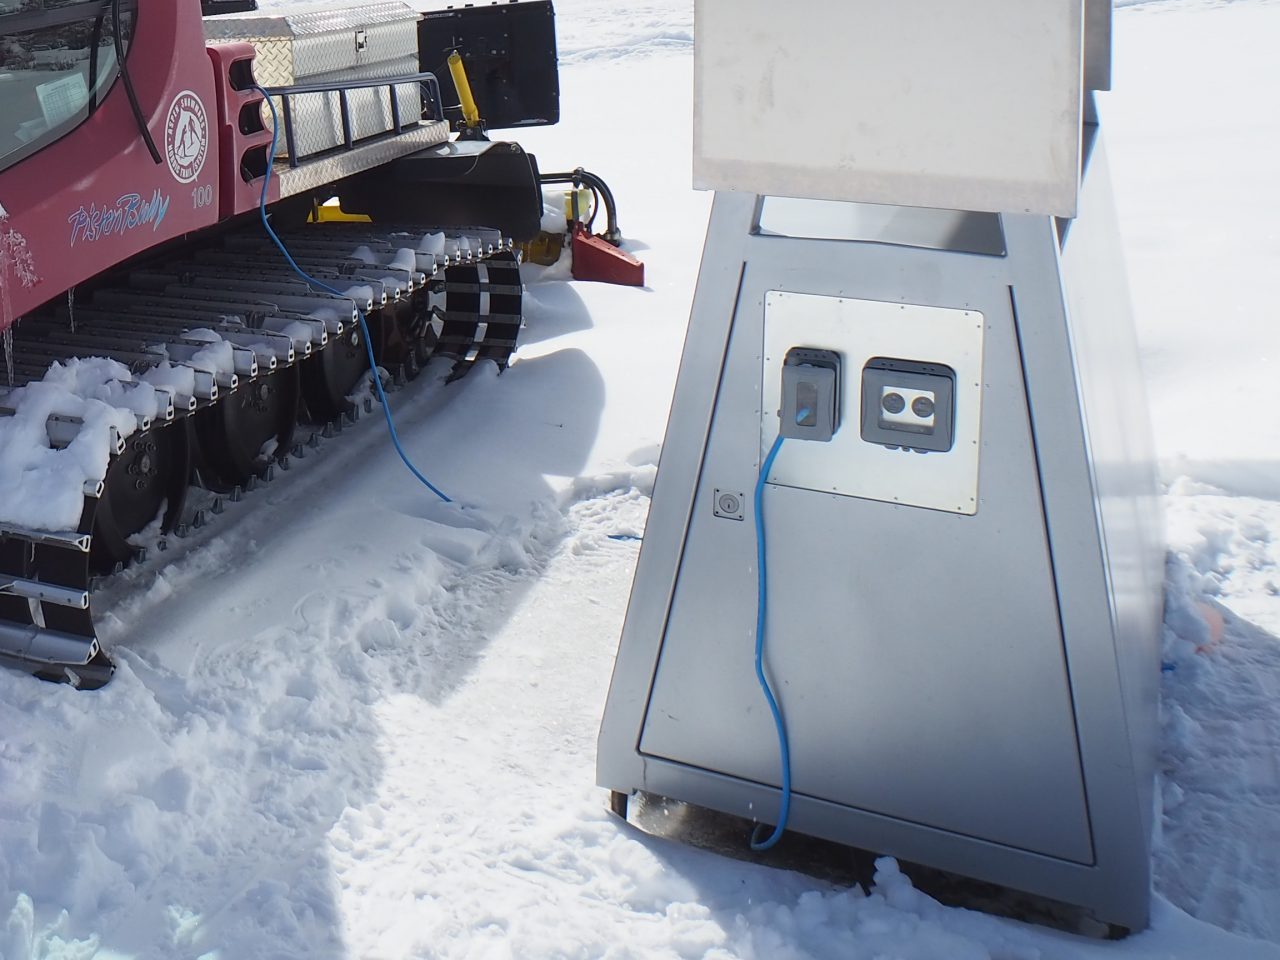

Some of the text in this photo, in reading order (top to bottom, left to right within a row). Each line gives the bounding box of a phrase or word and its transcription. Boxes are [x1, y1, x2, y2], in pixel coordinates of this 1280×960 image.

[167, 105, 180, 135] ASPEN
[179, 167, 193, 178] TRAIL
[193, 137, 206, 170] SYSTEM
[191, 184, 213, 209] 100
